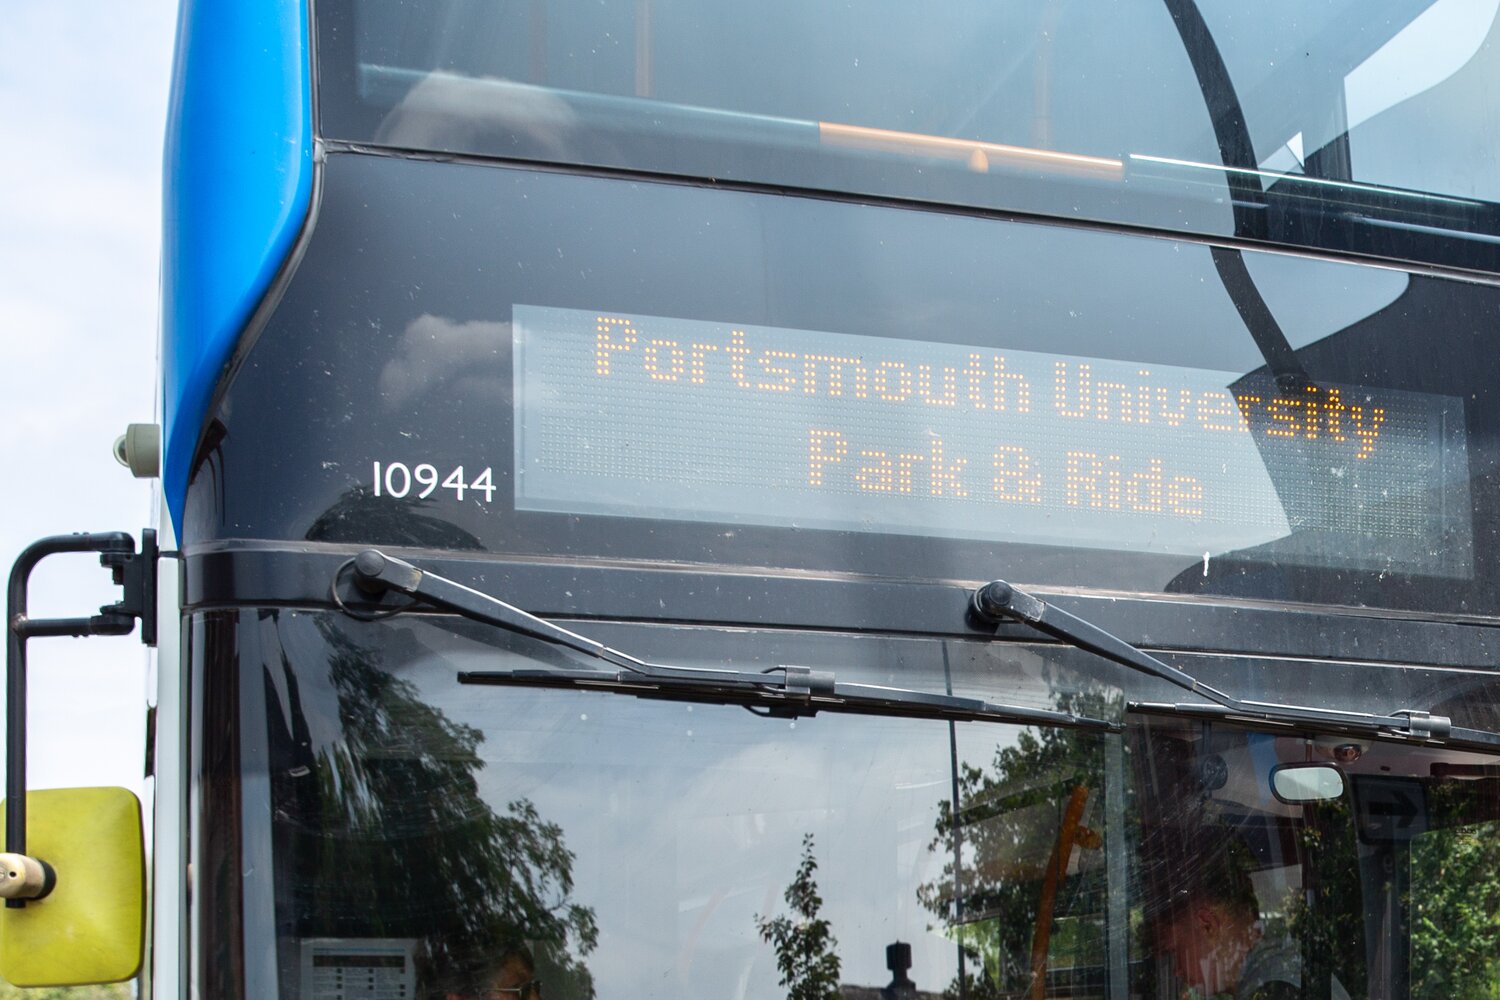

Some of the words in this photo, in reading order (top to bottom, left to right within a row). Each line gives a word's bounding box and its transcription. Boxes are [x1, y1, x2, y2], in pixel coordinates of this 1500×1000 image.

[596, 316, 1030, 413] Portsmouth
[1055, 361, 1385, 460] University
[372, 461, 497, 503] 10944
[808, 429, 968, 497] Park
[993, 446, 1042, 503] &
[1066, 451, 1202, 516] Ride
